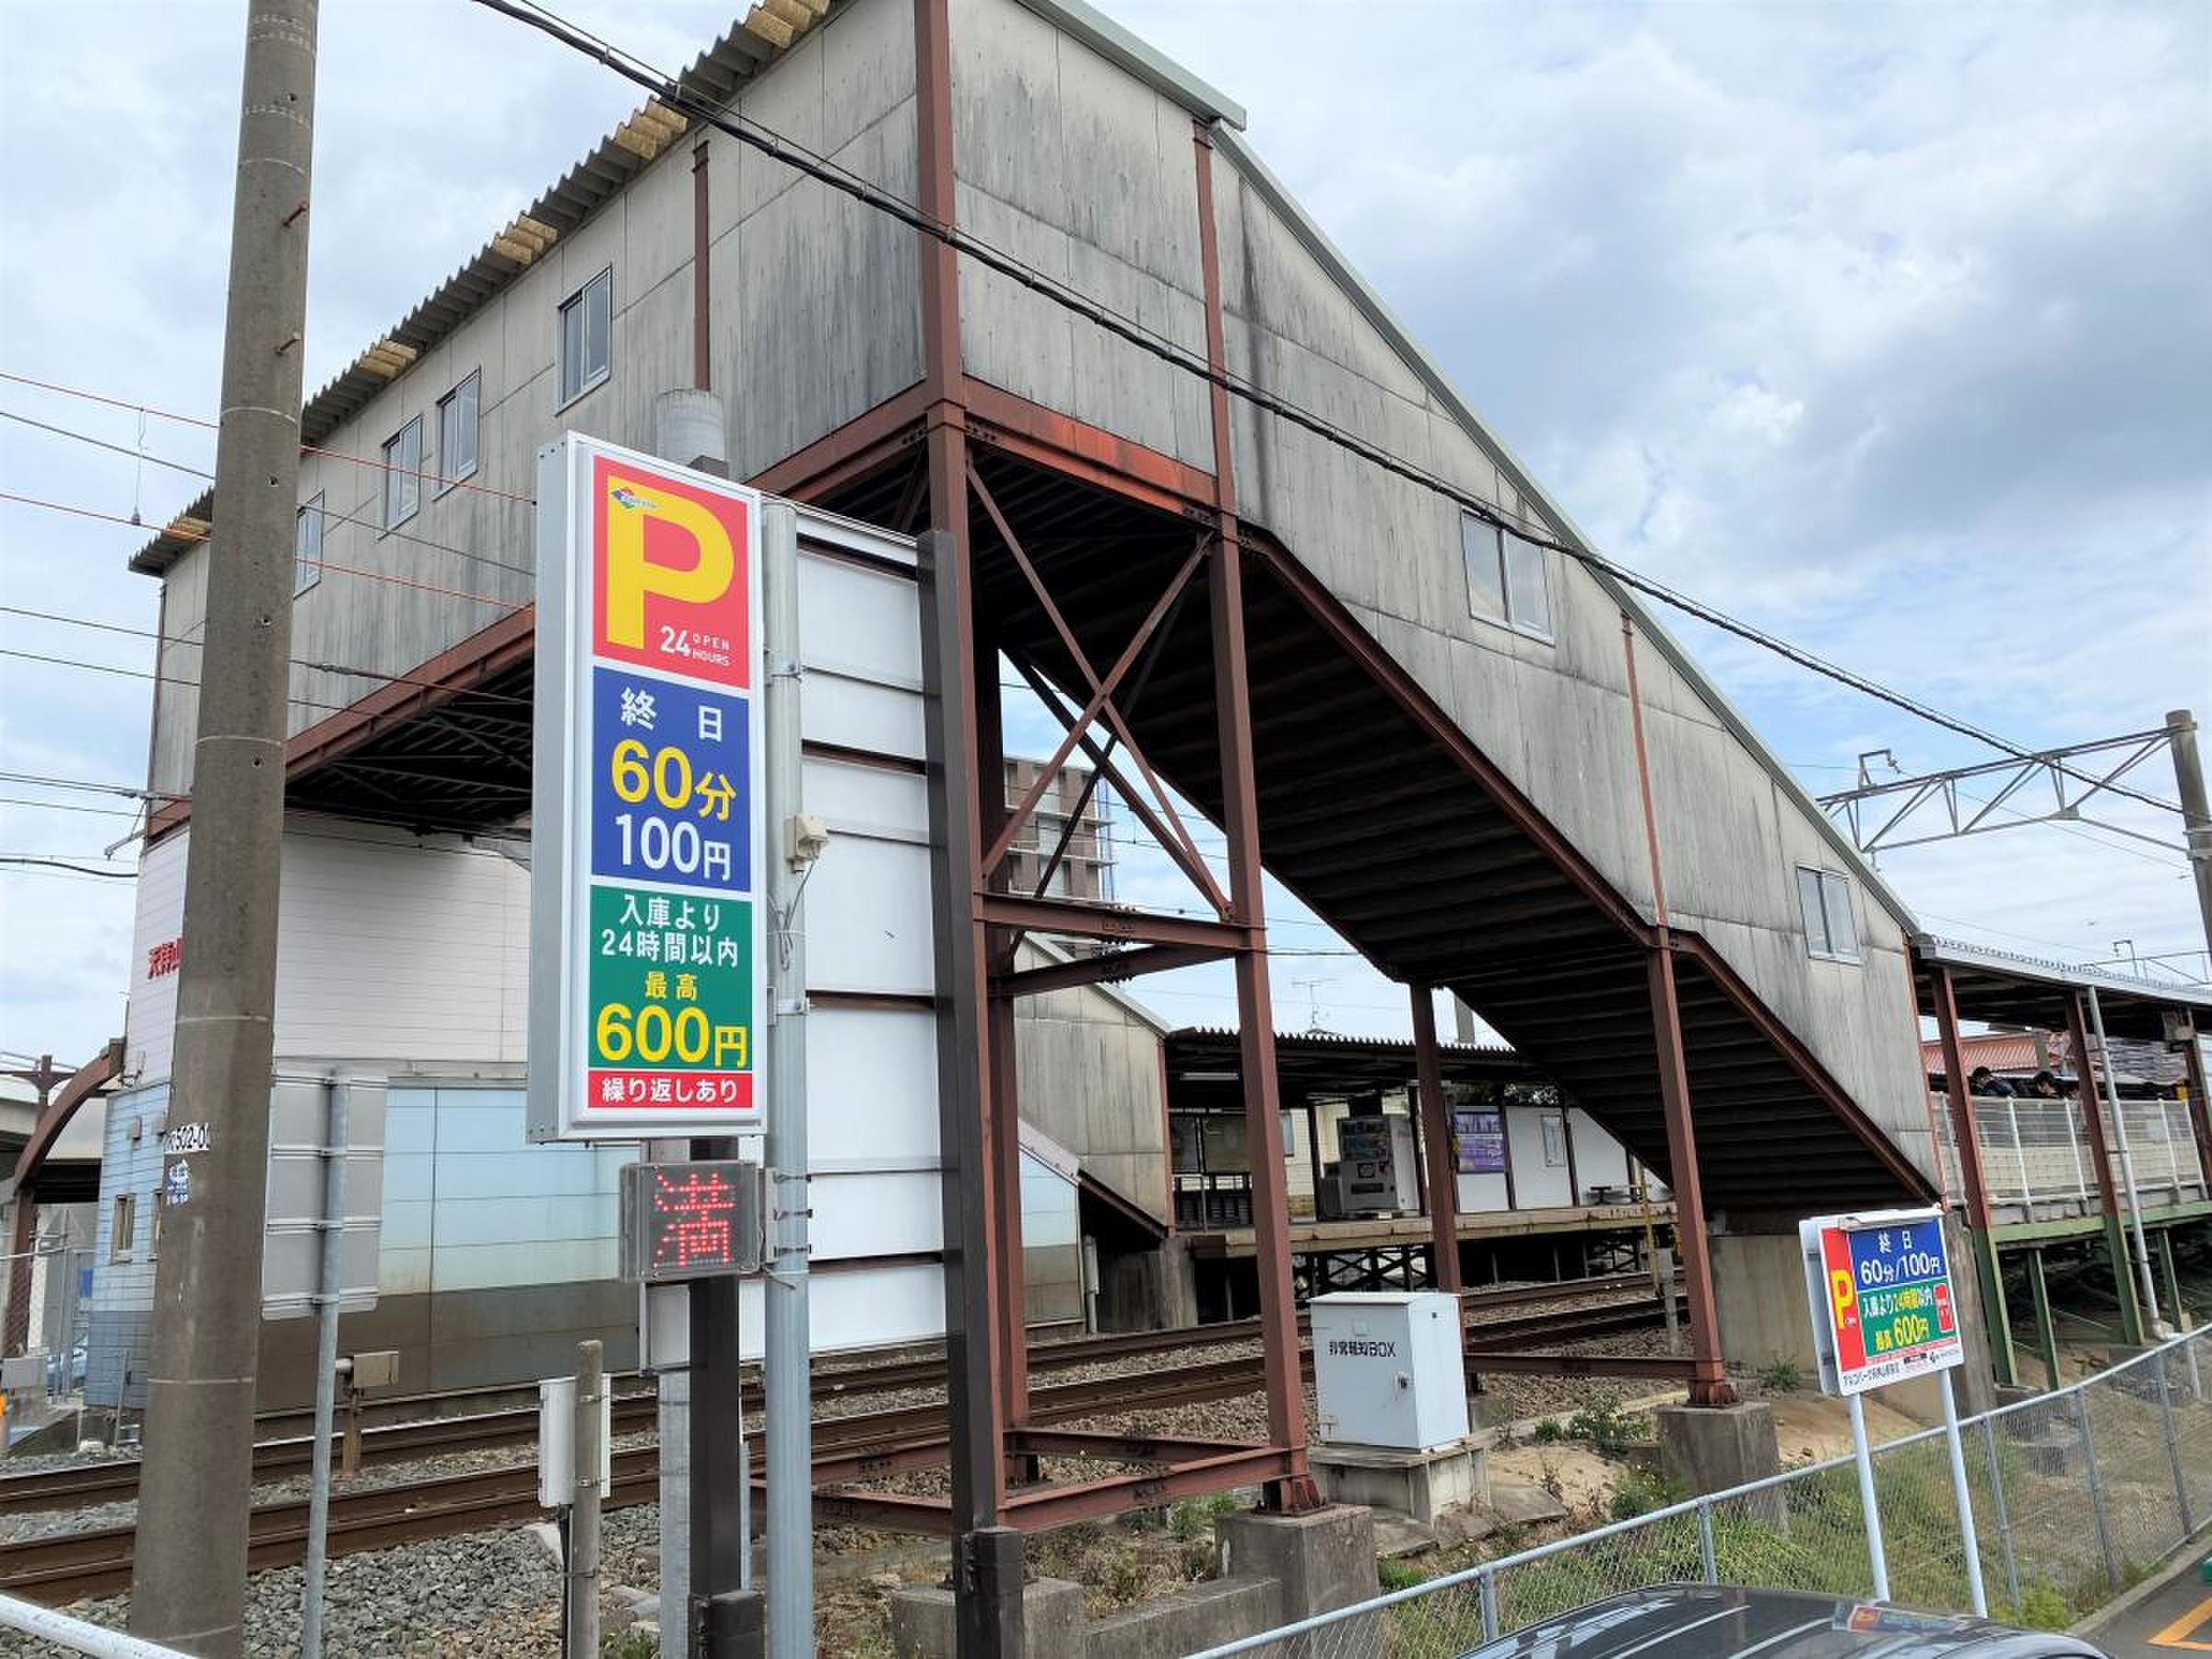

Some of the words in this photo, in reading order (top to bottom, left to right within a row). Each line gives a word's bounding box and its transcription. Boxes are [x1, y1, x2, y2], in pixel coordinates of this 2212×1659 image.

[606, 474, 735, 650] P
[660, 625, 692, 657] 24
[692, 632, 731, 651] OPEN
[692, 648, 731, 666] HOURS
[610, 737, 737, 821] 60分
[615, 813, 732, 882] 100円
[619, 893, 721, 932] 入庫より
[601, 927, 738, 969] 24時間以内
[644, 971, 699, 1001] 最高
[595, 1002, 747, 1068] 600円
[601, 1076, 738, 1103] 繰り返しあり
[653, 1166, 735, 1268] 満
[1830, 1268, 1854, 1330] P
